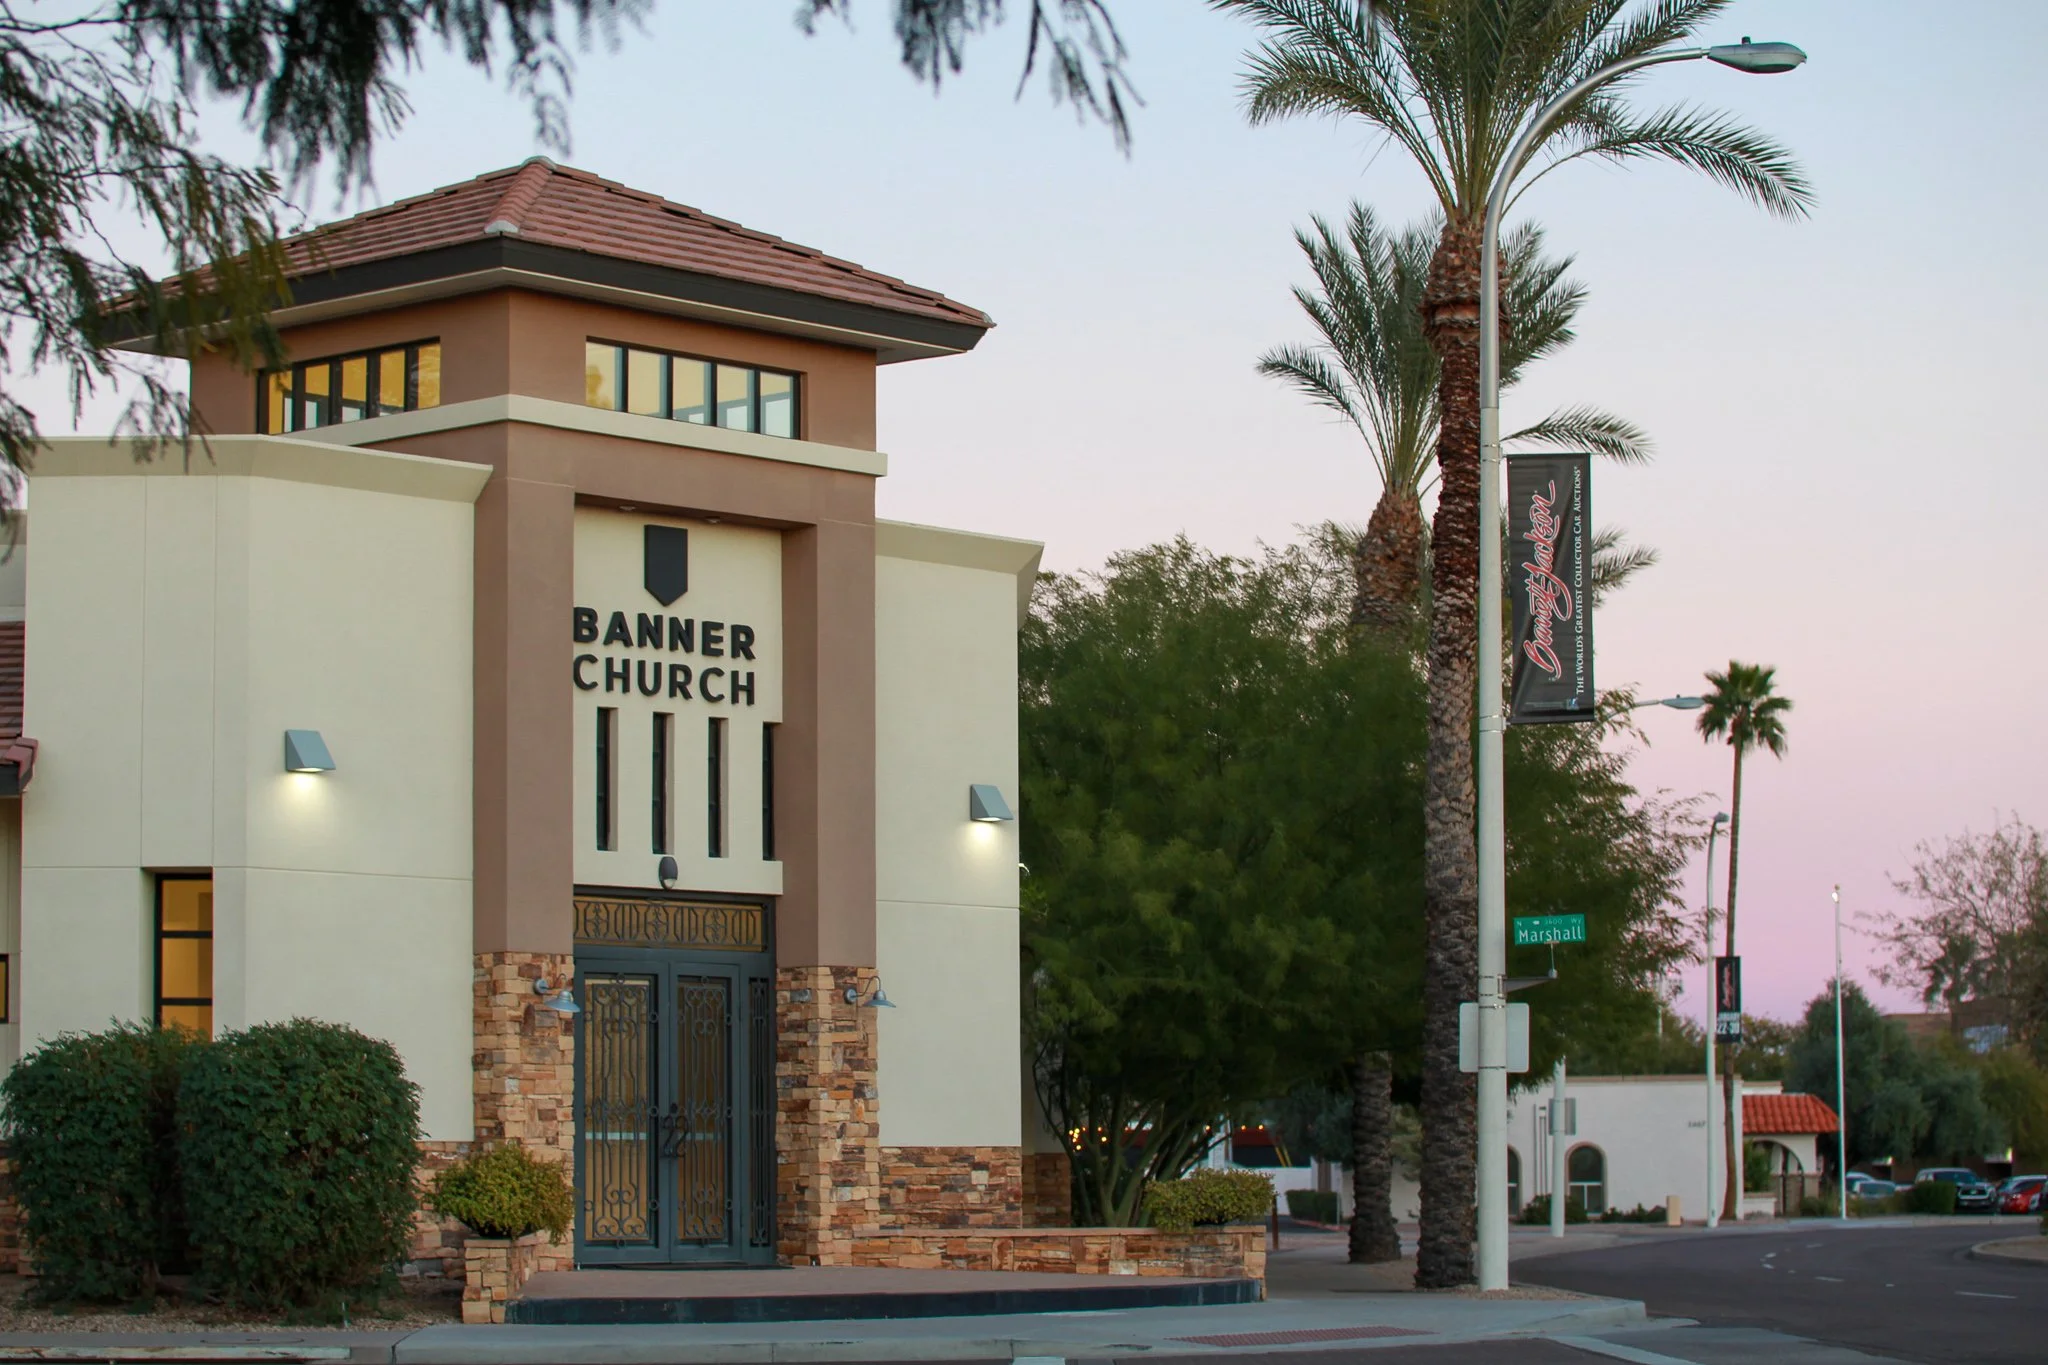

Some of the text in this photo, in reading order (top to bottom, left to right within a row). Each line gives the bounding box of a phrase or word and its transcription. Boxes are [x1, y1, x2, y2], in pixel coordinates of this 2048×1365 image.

[1573, 514, 1582, 534] CAR
[1521, 479, 1572, 680] Barrett-Jackson
[1573, 535, 1583, 588] COLLECTOR
[573, 606, 756, 660] BANNER
[1574, 589, 1583, 634] GREATEST
[1574, 635, 1584, 674] WORLD'S
[573, 653, 756, 706] CHURCH
[1575, 676, 1585, 695] THE
[1519, 925, 1582, 943] Marshall
